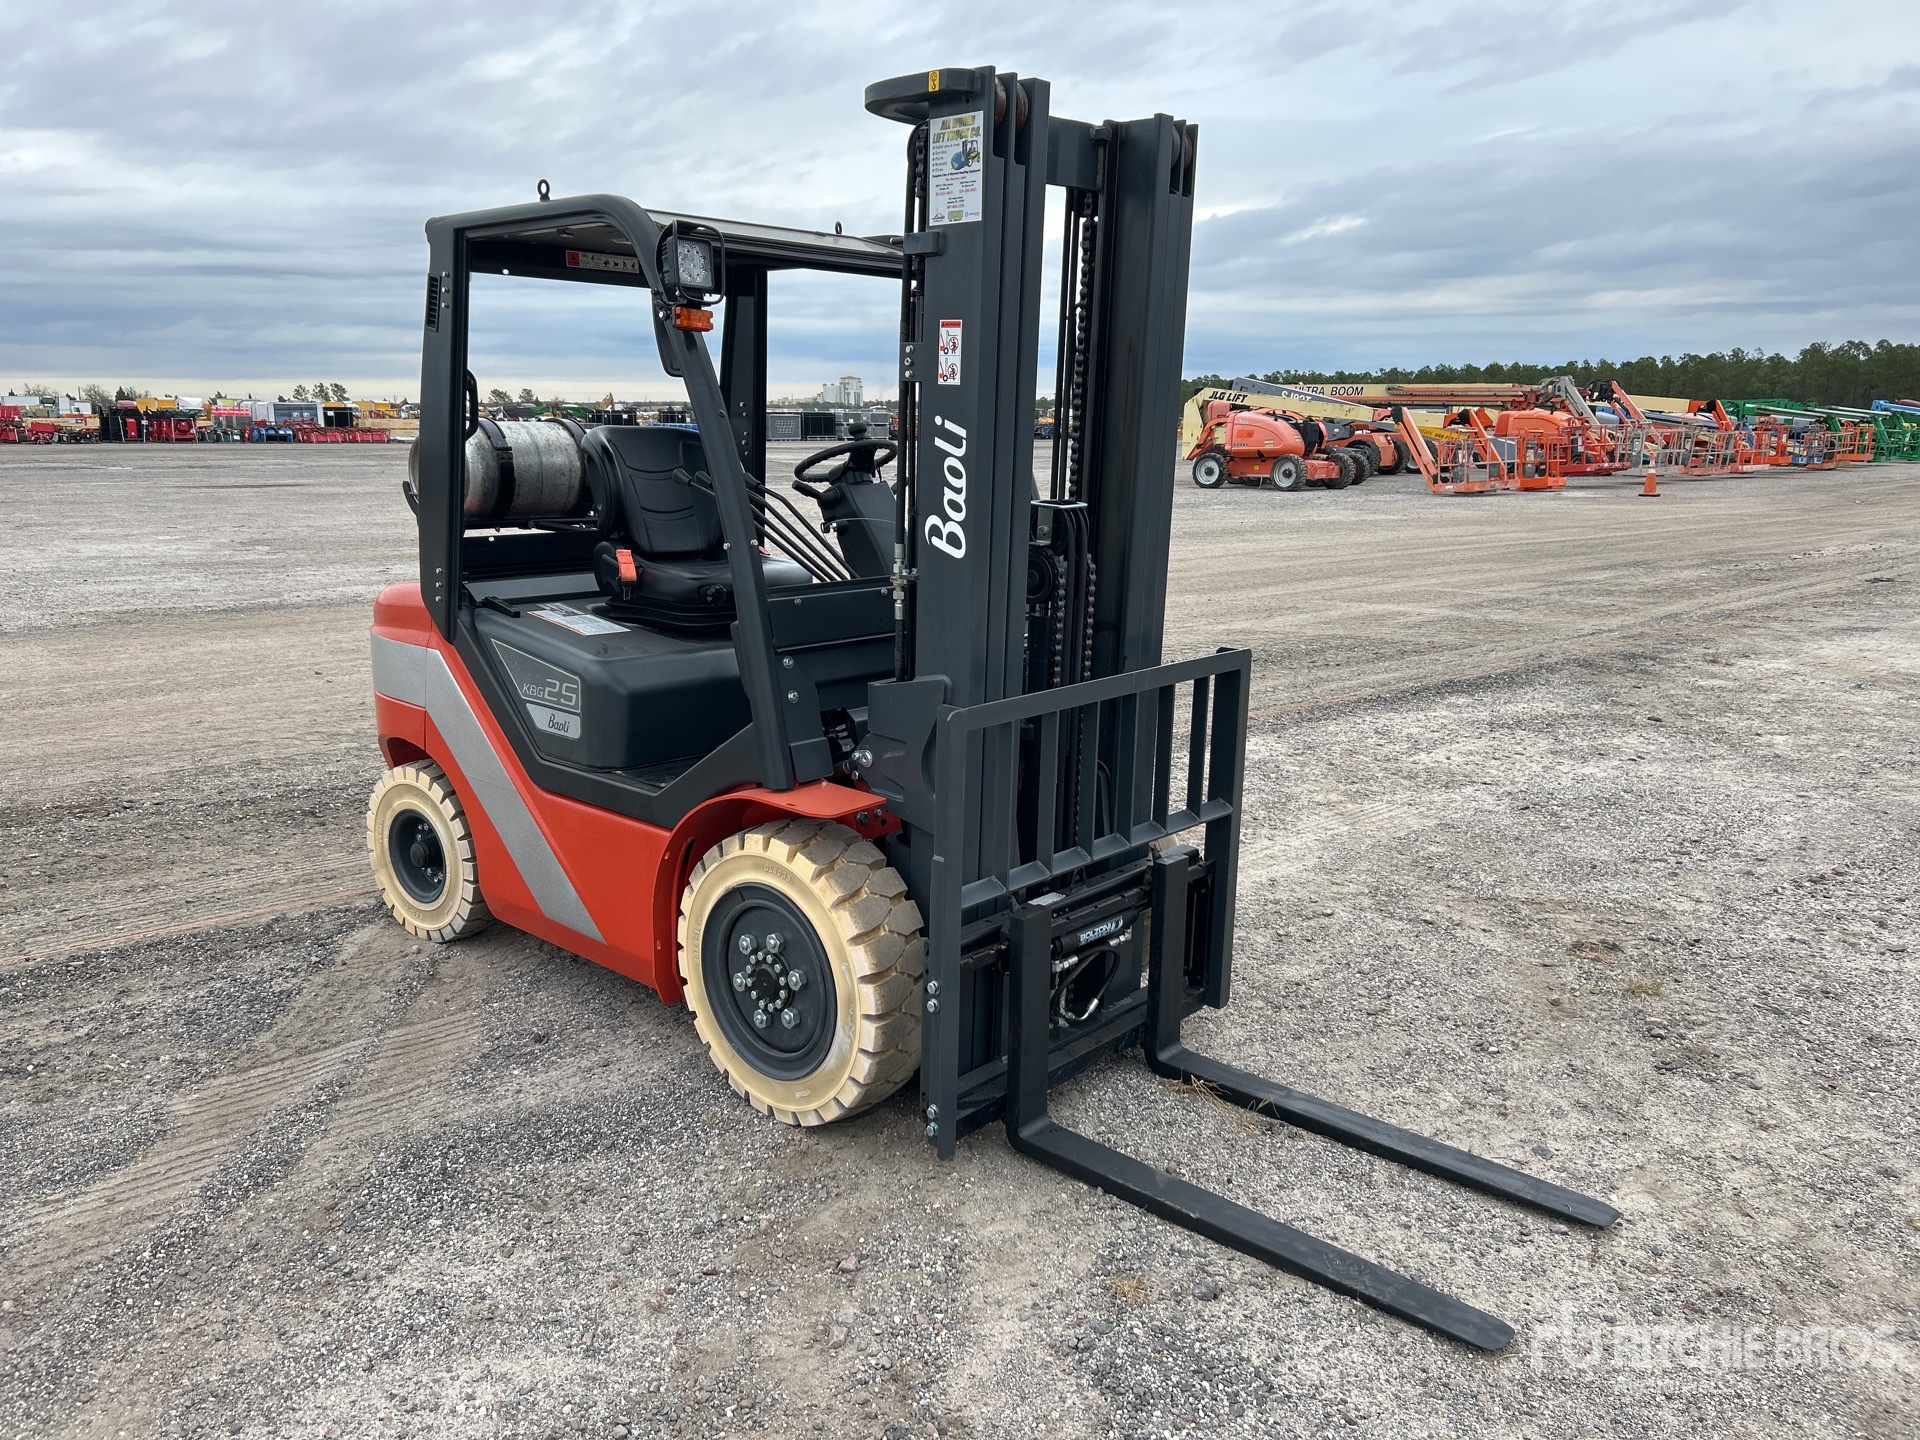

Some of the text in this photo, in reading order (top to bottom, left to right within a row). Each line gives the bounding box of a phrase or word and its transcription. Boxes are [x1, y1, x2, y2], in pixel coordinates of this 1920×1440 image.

[940, 119, 951, 130] ALL
[932, 132, 946, 144] LIFT
[1209, 391, 1248, 403] JLG LIFT
[1330, 386, 1364, 396] BOOM
[924, 415, 967, 559] Baoli
[547, 713, 570, 733] Baoli
